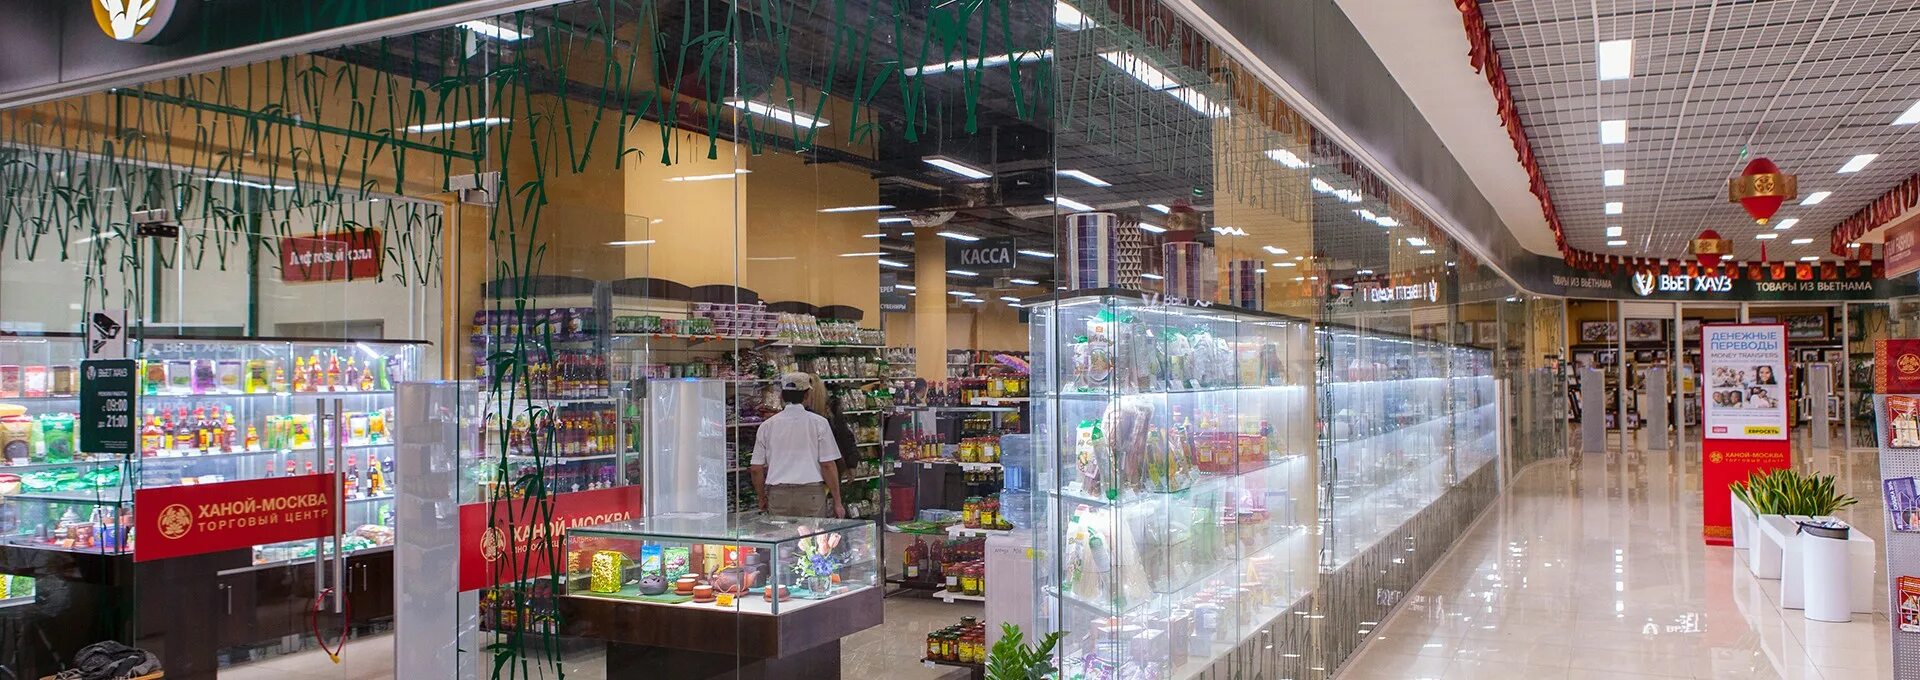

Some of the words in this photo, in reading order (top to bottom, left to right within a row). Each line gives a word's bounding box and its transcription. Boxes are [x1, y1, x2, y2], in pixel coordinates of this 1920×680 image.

[961, 247, 1010, 265] КАССА
[1580, 277, 1612, 289] ВЬЕТНАМА
[1660, 274, 1691, 291] ВЬЕТ
[1695, 275, 1732, 292] ХАУЗ
[1756, 282, 1797, 292] ТОВАРЫ
[1800, 282, 1814, 291] ИЗ
[1817, 280, 1872, 291] ВЬЕТНАМА
[1711, 331, 1777, 341] ДЕНЕЖНЫЕ
[1711, 341, 1778, 351] ПЕРЕВОДЫ
[106, 399, 128, 412] 09:00
[106, 415, 128, 428] 21:00
[198, 493, 328, 519] ХАНОЙ-МОСКВА
[198, 513, 278, 532] ТОРГОВЫЙ
[285, 508, 329, 524] ЦЕНТР
